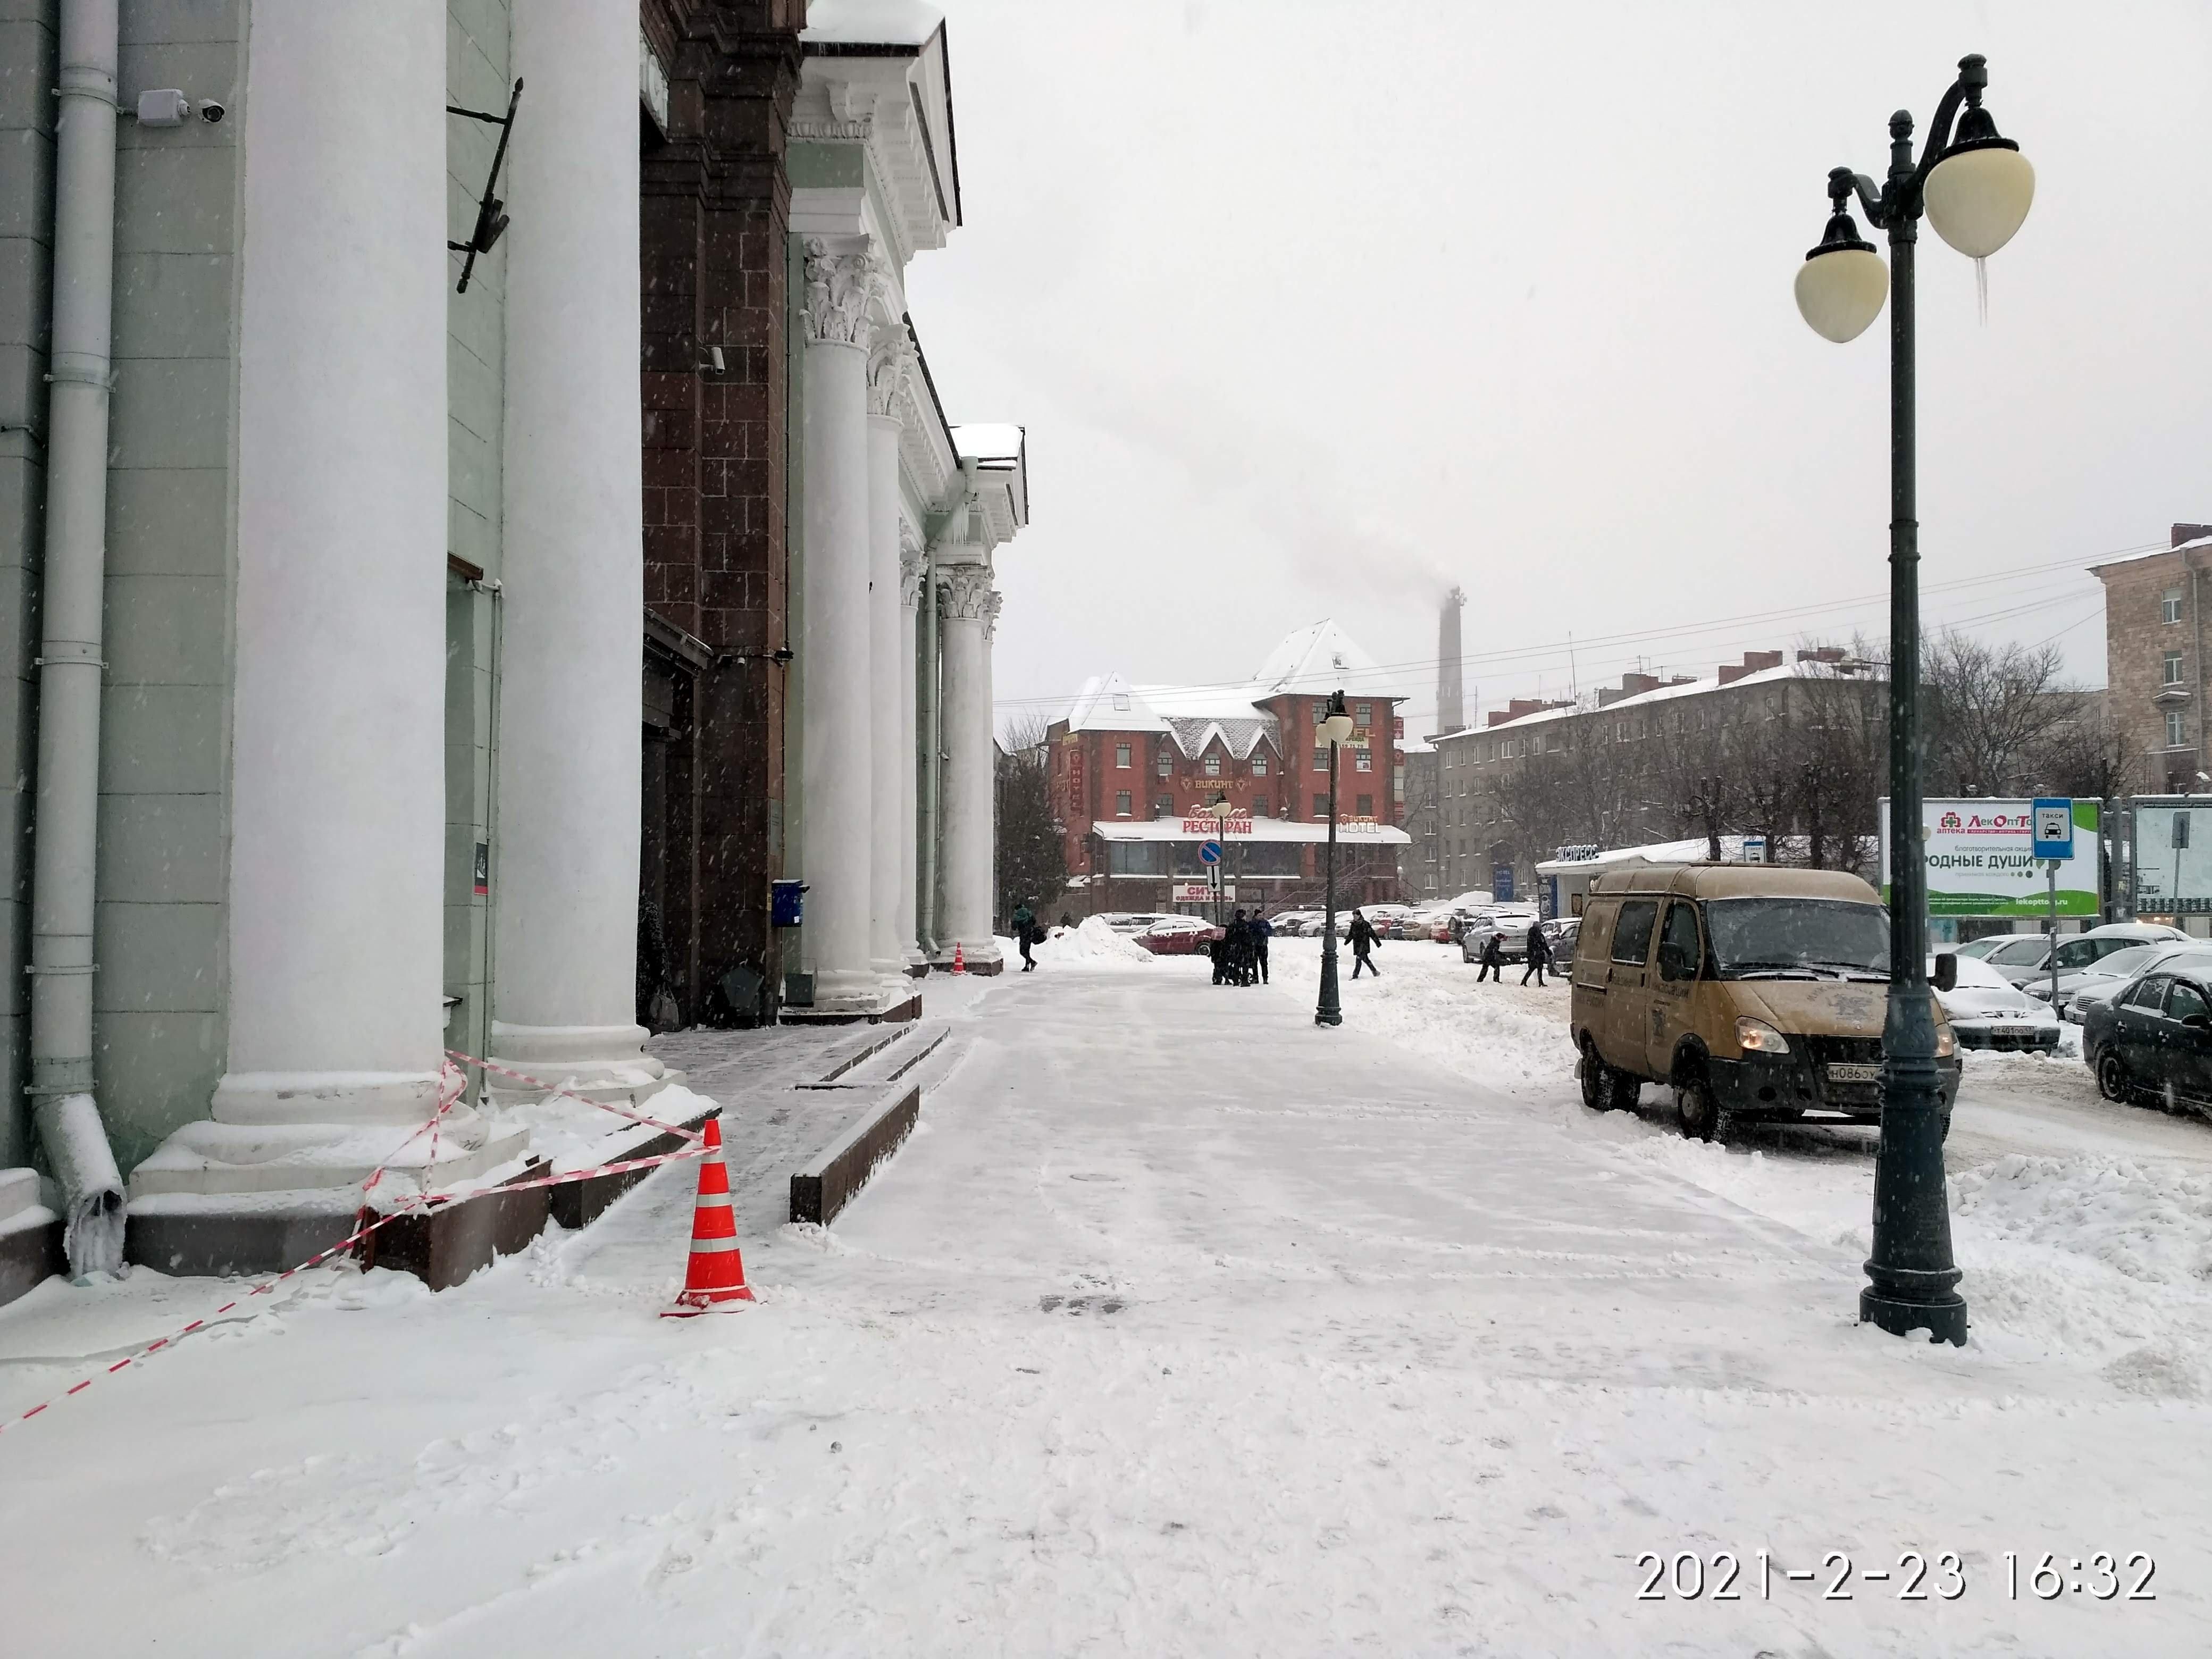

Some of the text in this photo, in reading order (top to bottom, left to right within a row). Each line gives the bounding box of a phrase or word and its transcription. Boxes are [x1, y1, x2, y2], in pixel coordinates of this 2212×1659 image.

[1339, 822, 1381, 833] HOTEL
[1968, 815, 2032, 827] ЛекОптТо
[1556, 844, 1598, 862] ЭКСПРЕСС
[1988, 855, 2033, 869] ДУШИ
